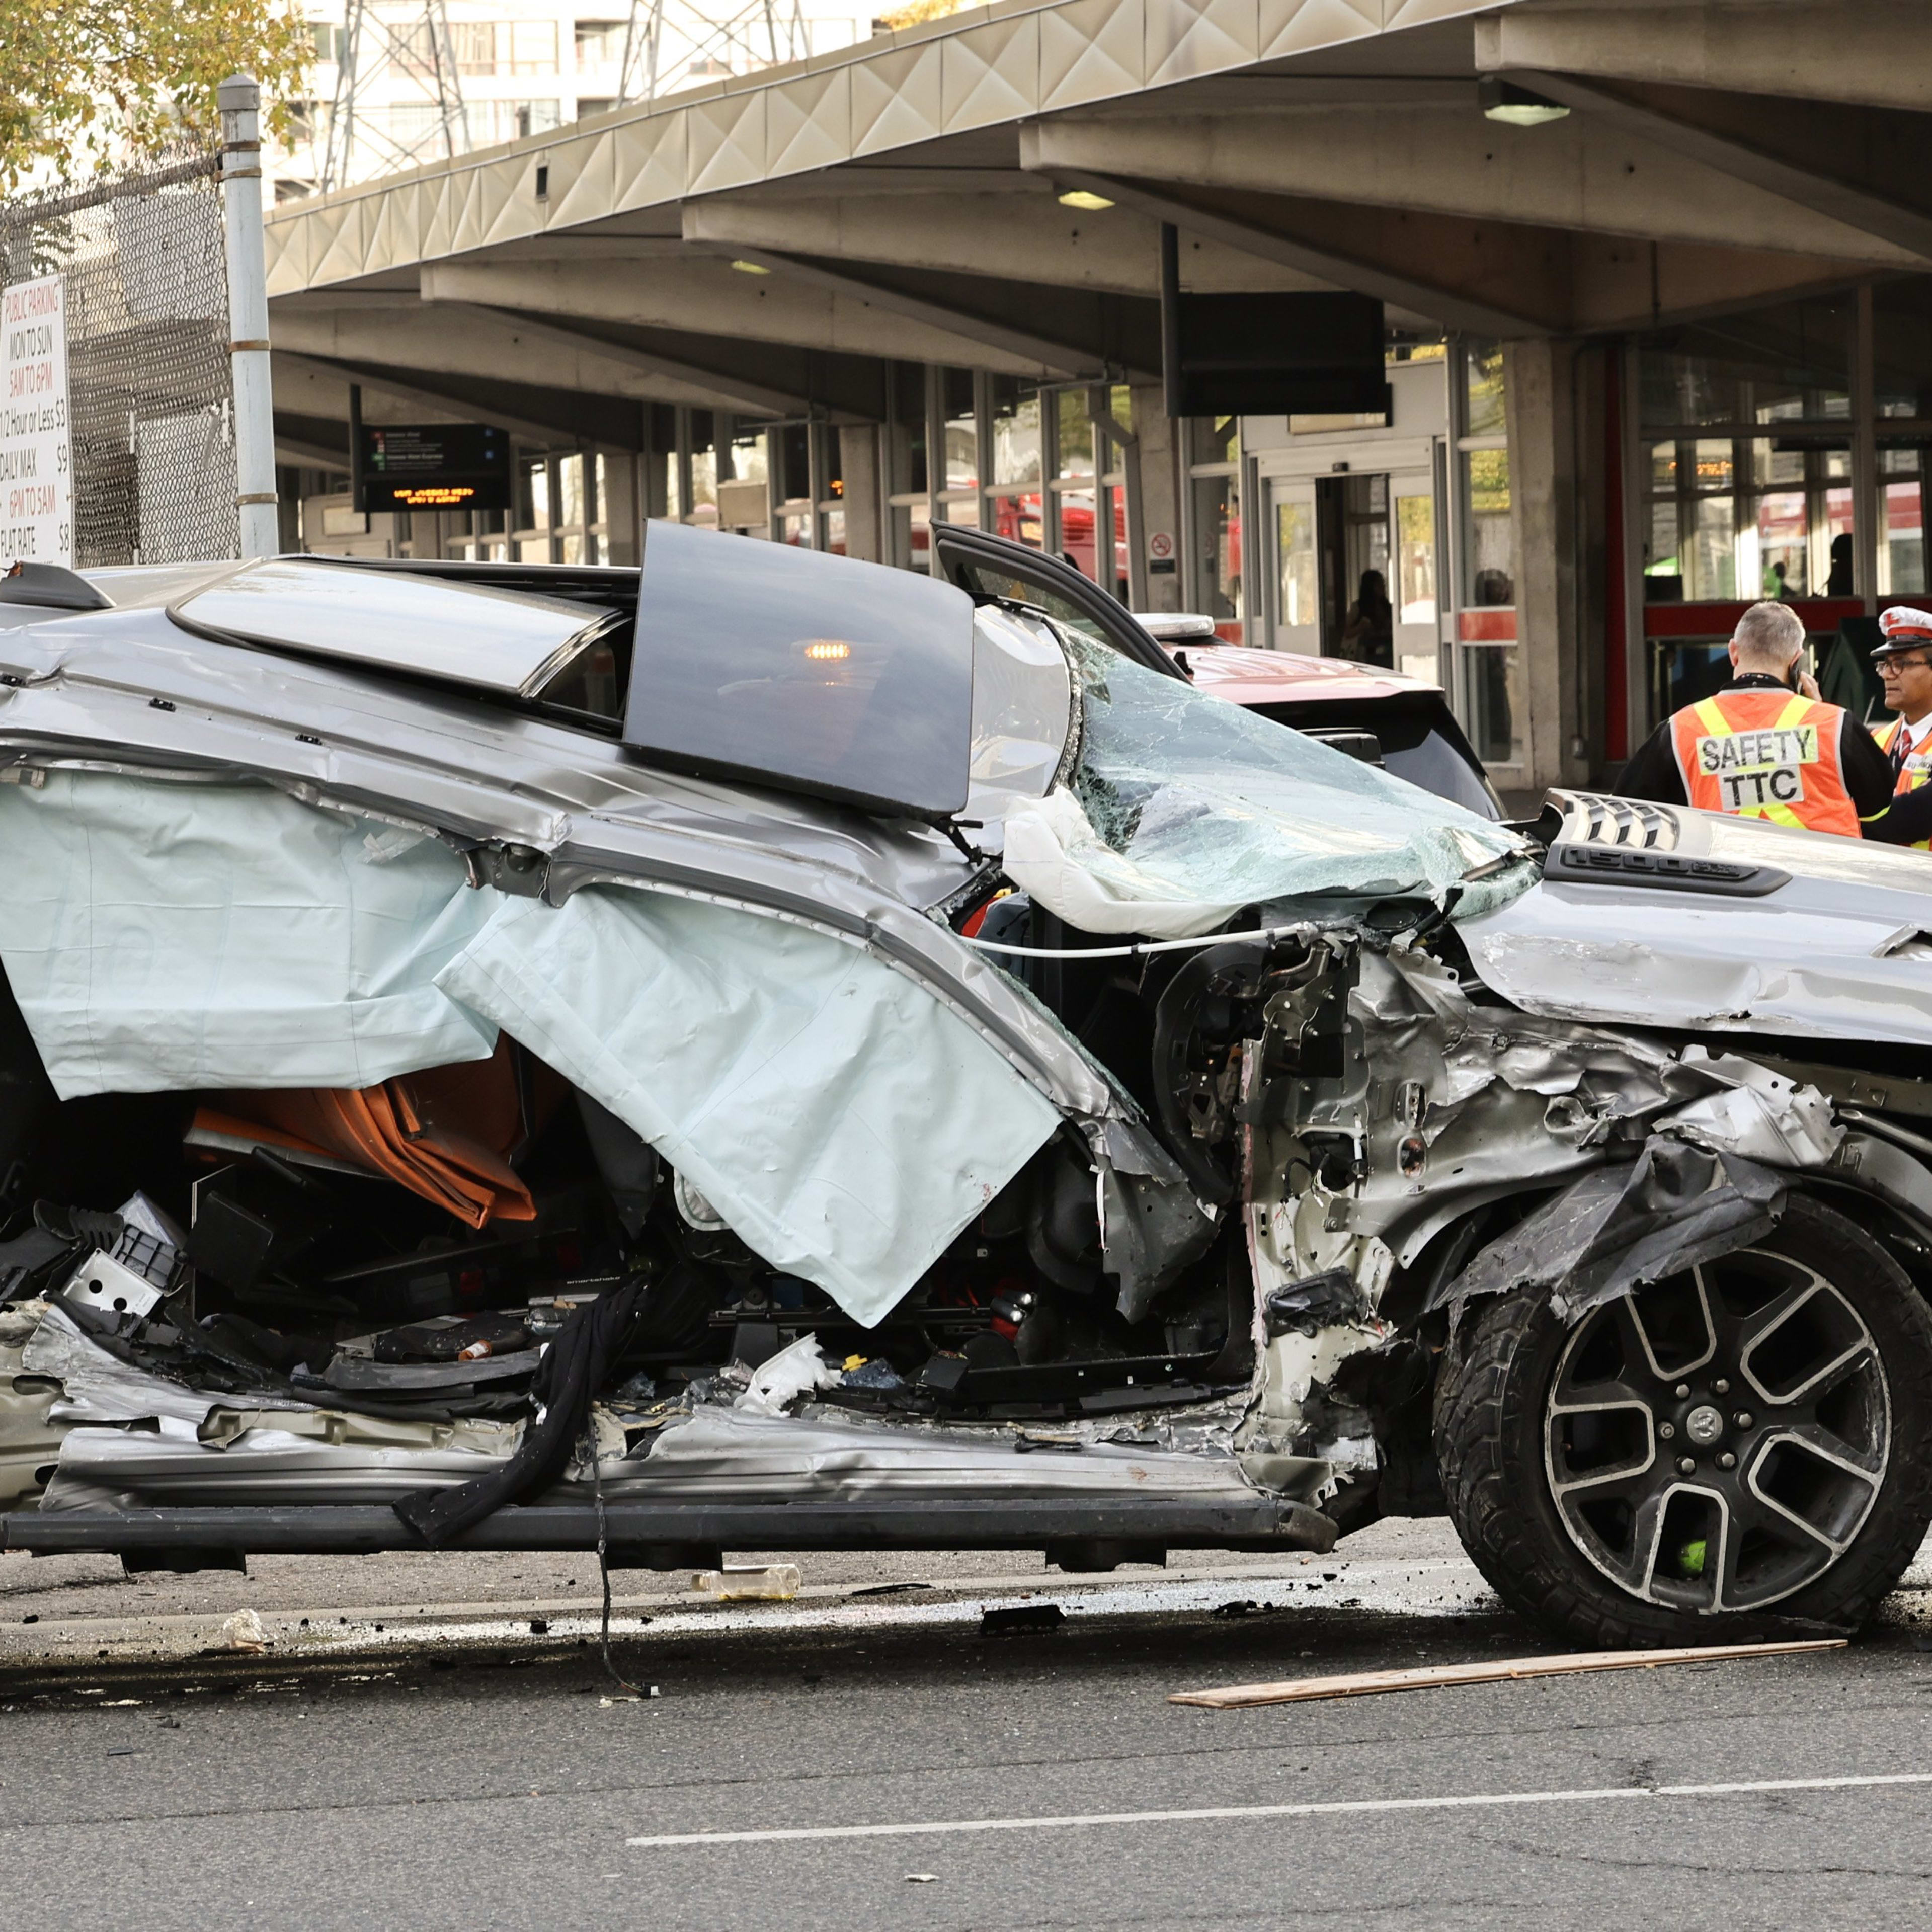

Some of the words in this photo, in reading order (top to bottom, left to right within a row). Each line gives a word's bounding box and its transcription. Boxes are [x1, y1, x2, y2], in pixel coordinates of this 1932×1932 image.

[6, 289, 27, 324] PUBLIC
[29, 283, 58, 318] PARKING
[10, 330, 26, 361] MON
[27, 328, 36, 358] TO
[37, 324, 52, 355] SUN
[10, 367, 24, 398] 5AM
[26, 365, 35, 394] TO
[36, 361, 52, 393] 6PM
[11, 407, 27, 437] Hour
[29, 411, 36, 434] or
[38, 402, 54, 432] Less
[56, 395, 65, 431] $3
[0, 450, 19, 482] DAILY
[20, 448, 37, 479] MAX
[57, 441, 68, 477] $9
[10, 488, 25, 518] 6PM
[26, 487, 36, 516] TO
[38, 484, 56, 515] 5AM
[1, 528, 16, 558] FLAT
[18, 526, 36, 557] RATE
[59, 520, 69, 555] $8
[1702, 729, 1811, 771] SAFETY
[1724, 769, 1798, 806] TTC
[1569, 847, 1688, 872] 1500
